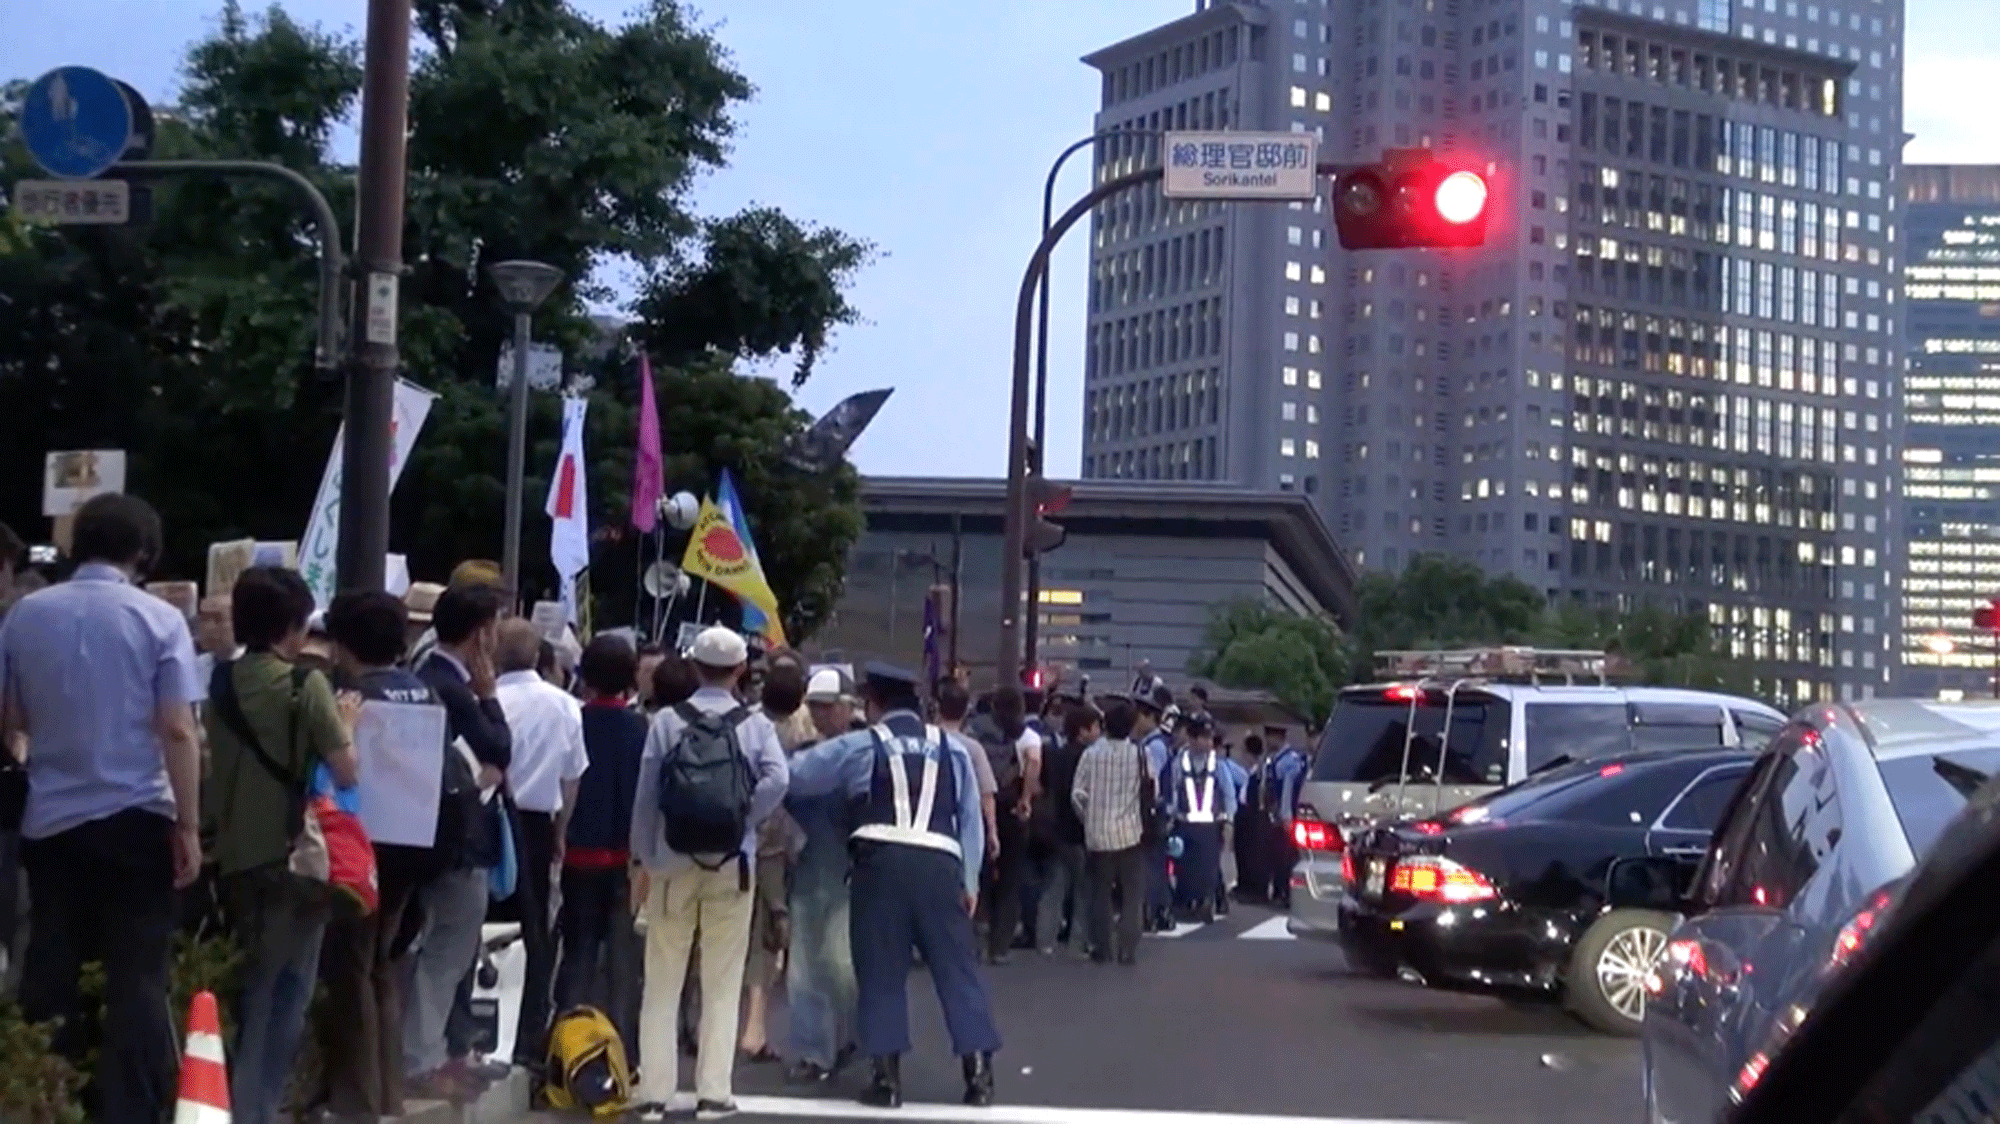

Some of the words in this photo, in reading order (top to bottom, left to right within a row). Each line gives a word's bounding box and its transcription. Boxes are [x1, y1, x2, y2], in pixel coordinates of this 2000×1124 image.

[1172, 142, 1309, 169] 総理官邸前
[1203, 171, 1278, 187] Sorikantei
